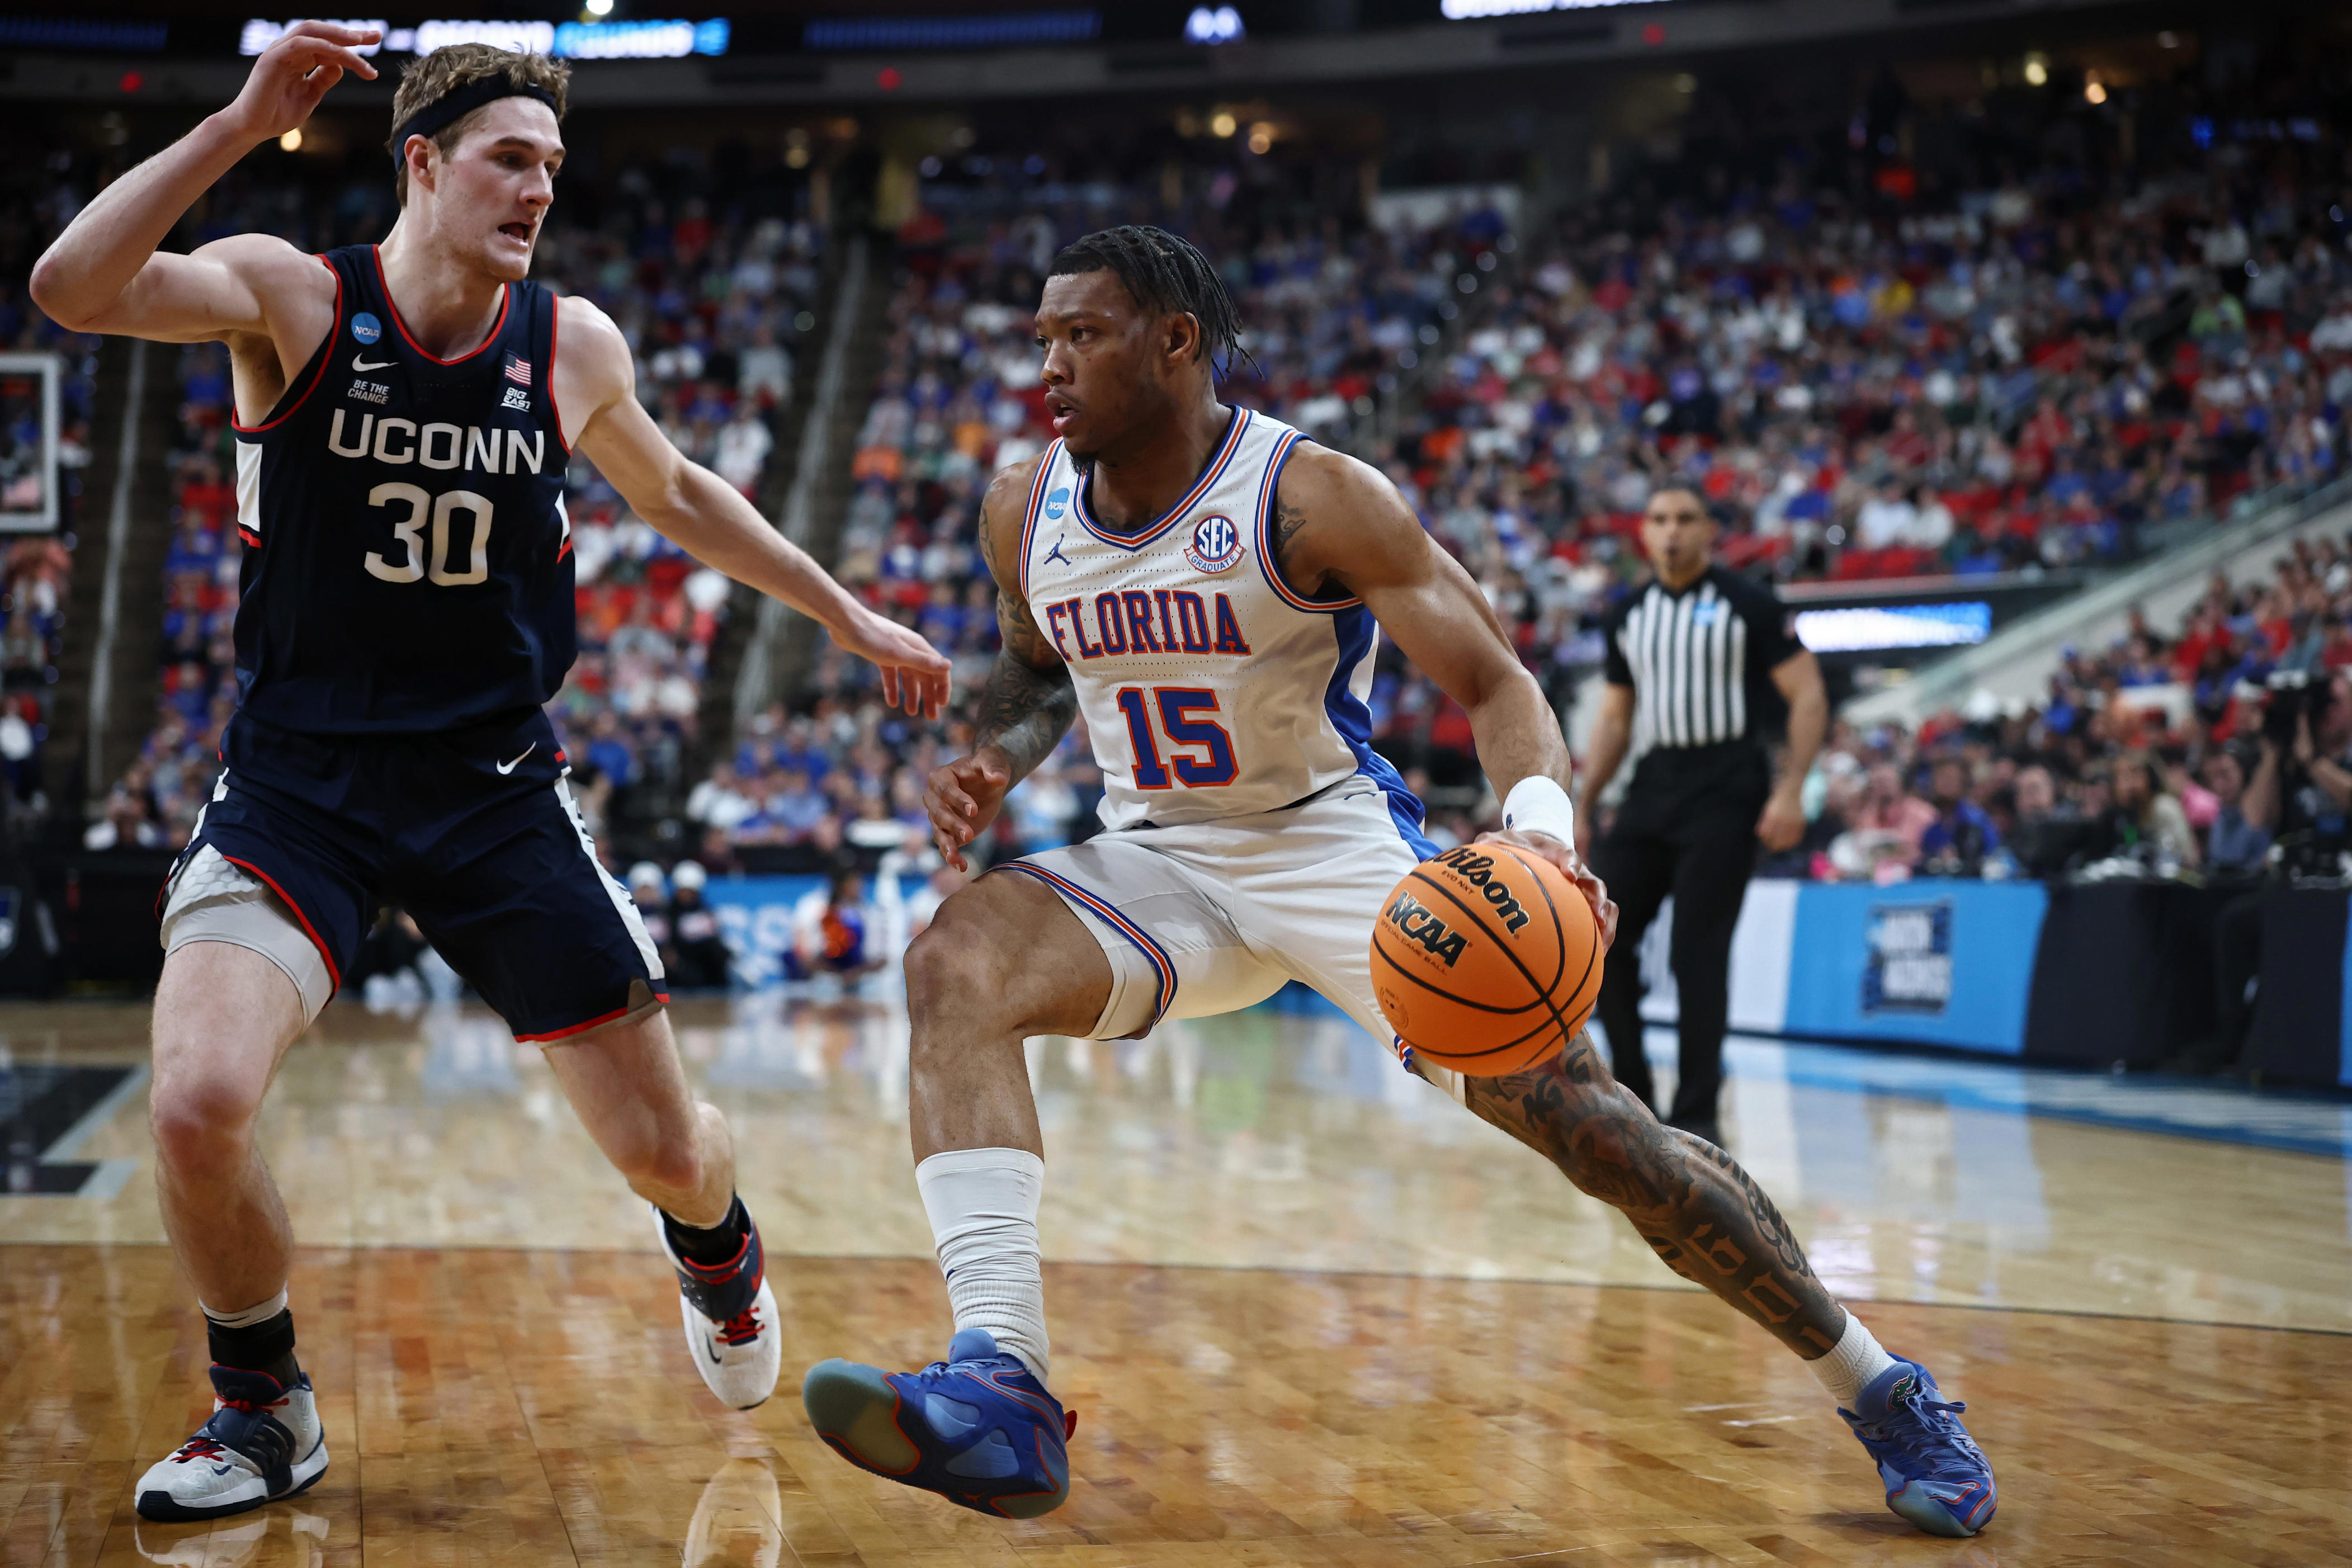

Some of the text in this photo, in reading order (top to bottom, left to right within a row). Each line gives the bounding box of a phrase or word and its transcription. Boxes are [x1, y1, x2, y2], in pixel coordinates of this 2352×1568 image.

[355, 325, 380, 338] NCAA
[348, 388, 389, 404] CHANGE
[353, 380, 390, 395] BE THE
[503, 395, 531, 409] EAST
[506, 386, 527, 400] BIG
[328, 408, 544, 474] UCONN
[364, 481, 494, 587] 30
[1197, 518, 1233, 558] SEC
[1191, 554, 1236, 572] GRADUATE
[1046, 589, 1251, 663] FLORIDA
[1116, 687, 1240, 790] 15
[1441, 870, 1475, 895] EVO NXT
[1385, 890, 1470, 969] NCAA
[1401, 938, 1421, 957] GAME
[1424, 956, 1447, 976] BALL
